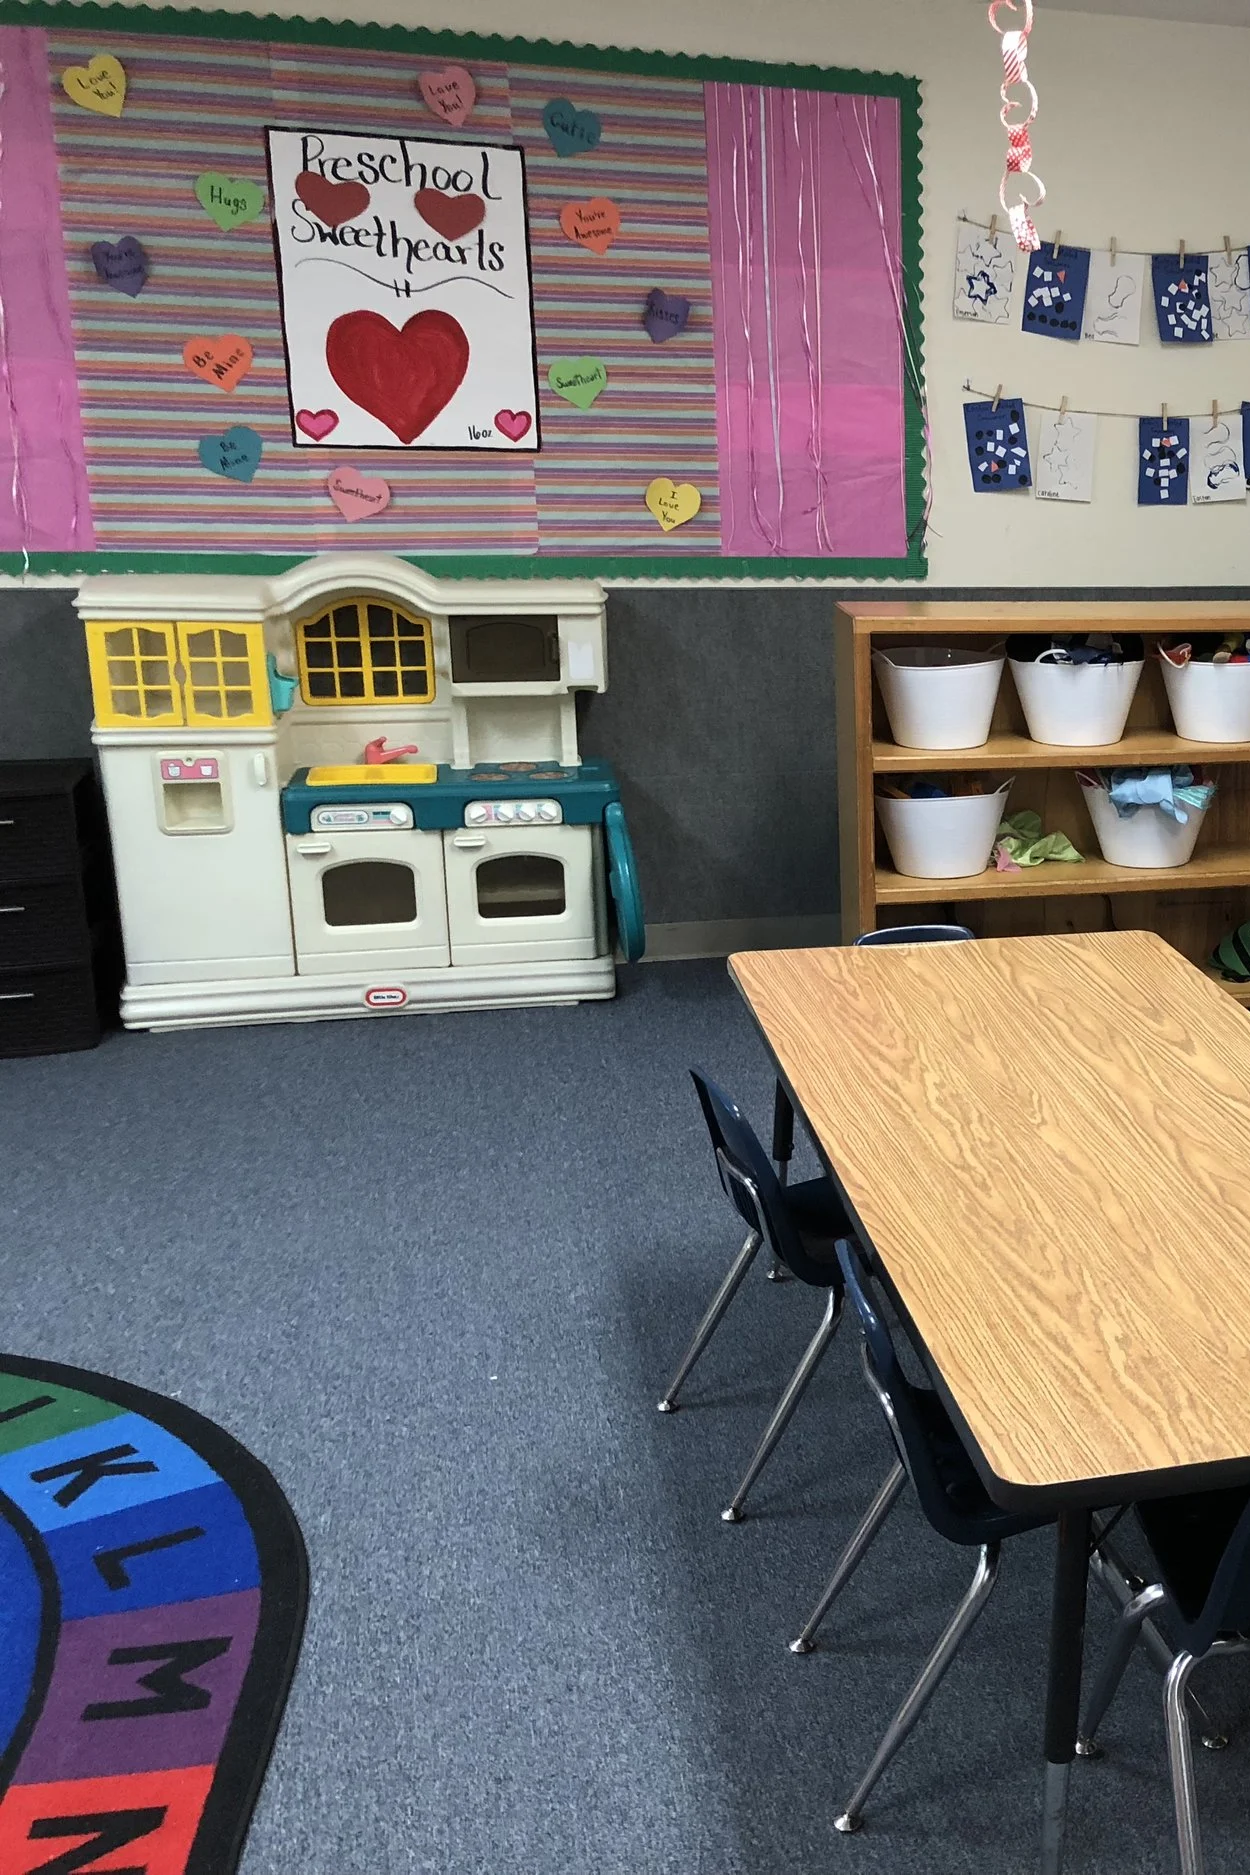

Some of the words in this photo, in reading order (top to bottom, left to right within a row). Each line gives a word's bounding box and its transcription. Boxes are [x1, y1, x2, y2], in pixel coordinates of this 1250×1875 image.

[77, 69, 111, 90] Love
[428, 80, 459, 95] Love
[300, 135, 502, 200] Preschool
[210, 185, 247, 215] Hugs
[291, 198, 504, 274] Sweethearts
[191, 349, 214, 368] Be
[211, 347, 245, 381] Mine
[658, 497, 680, 511] Love
[670, 491, 677, 499] I
[661, 510, 676, 524] You
[30, 1443, 160, 1508] K
[92, 1526, 206, 1590] L
[80, 1636, 233, 1722] M
